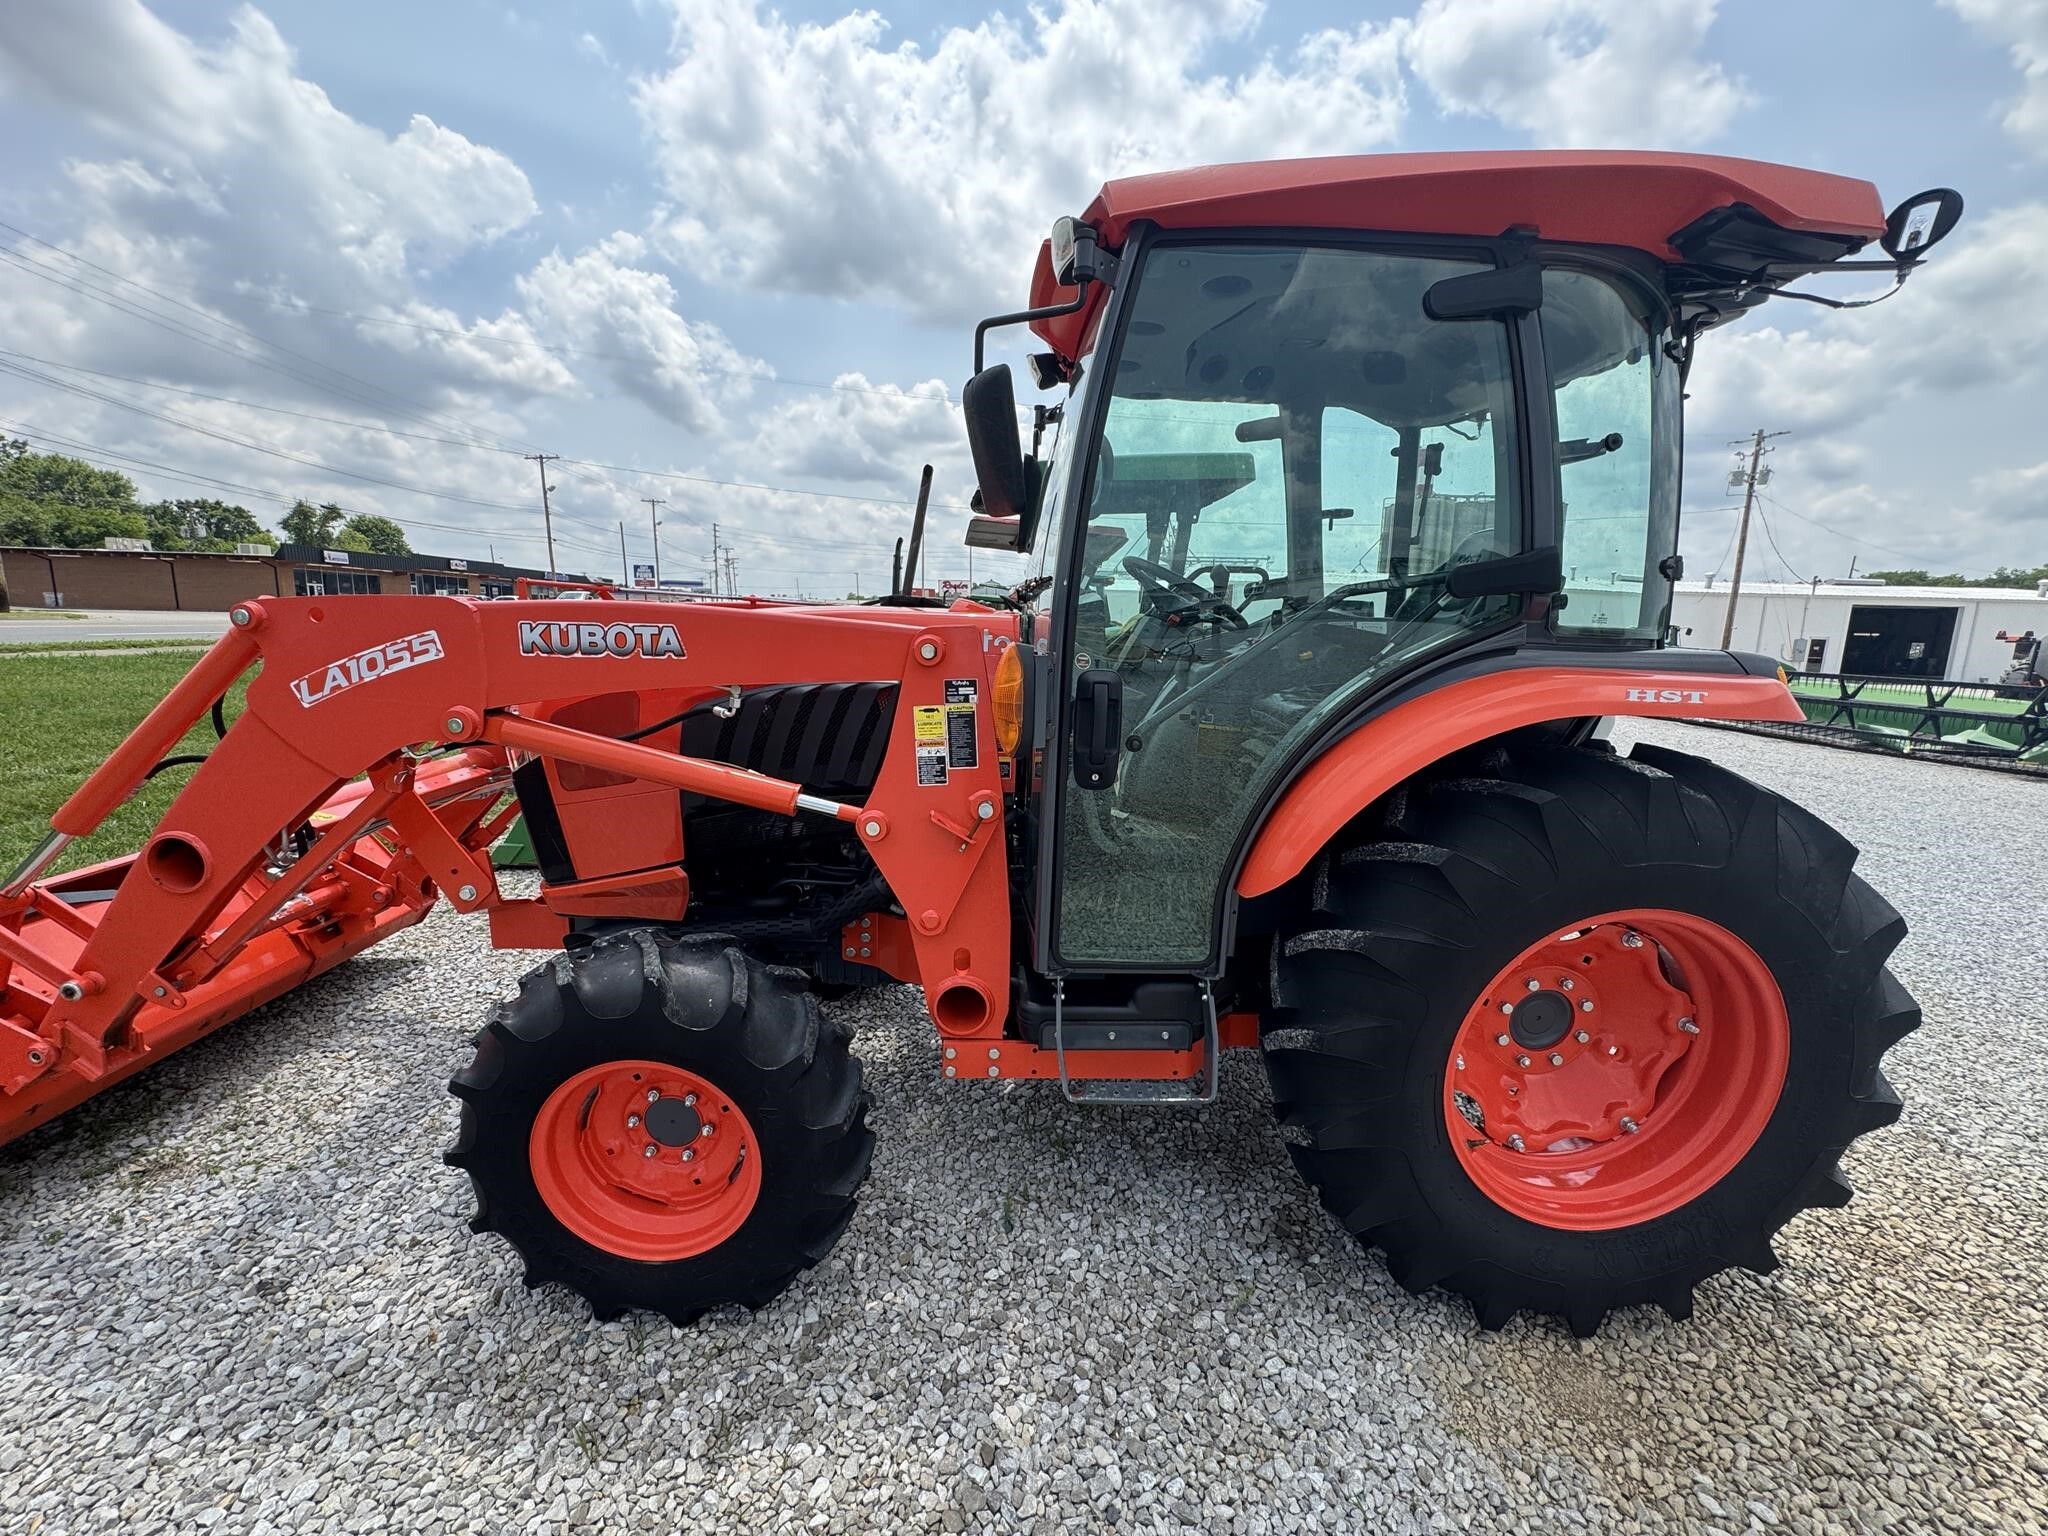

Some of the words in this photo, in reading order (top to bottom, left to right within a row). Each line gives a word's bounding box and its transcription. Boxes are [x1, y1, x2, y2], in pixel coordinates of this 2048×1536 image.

[521, 623, 684, 658] KUBOTA
[299, 633, 438, 704] LA1055
[1626, 688, 1709, 704] HST
